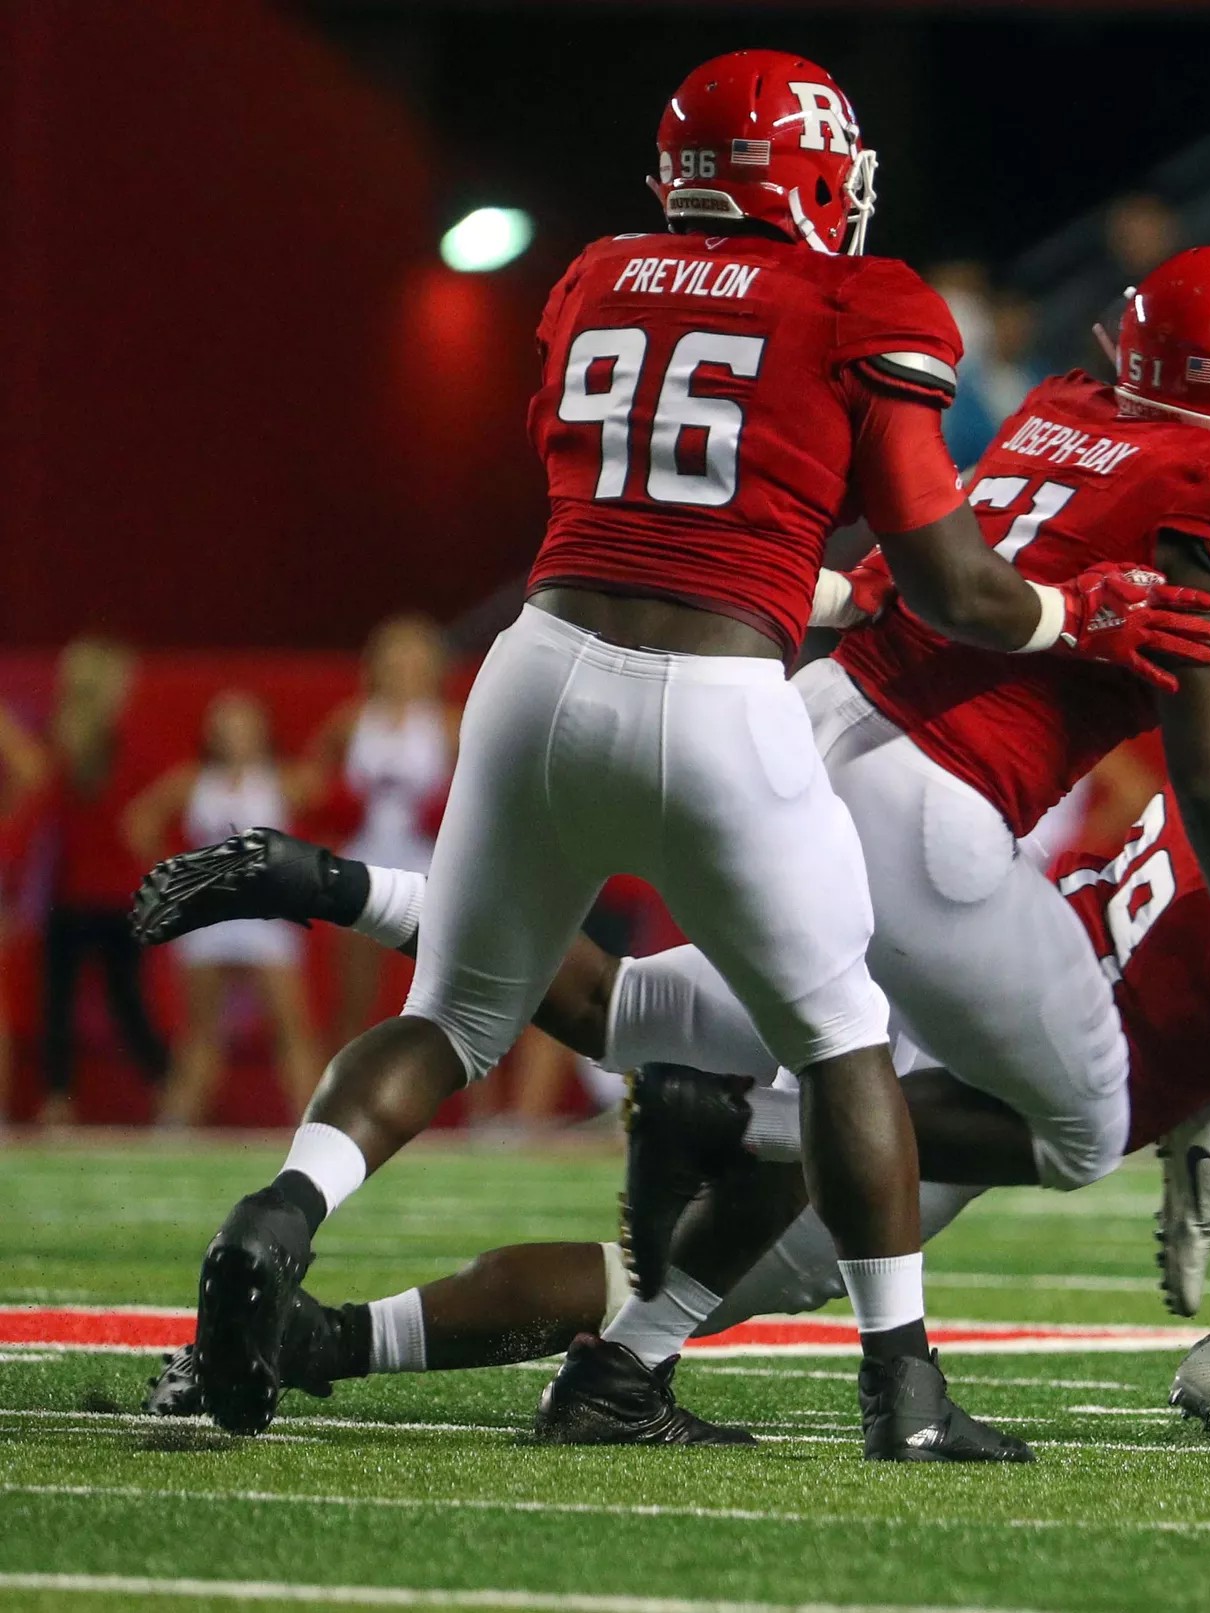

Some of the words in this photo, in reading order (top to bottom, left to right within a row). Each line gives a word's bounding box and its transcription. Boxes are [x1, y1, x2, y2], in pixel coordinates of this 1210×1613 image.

[788, 81, 849, 155] R
[680, 149, 716, 178] 96
[669, 197, 731, 212] RUTGERS
[613, 257, 760, 298] PREVILON
[1129, 350, 1162, 388] 51
[558, 327, 768, 506] 96
[1002, 415, 1140, 475] JOSEPH-DAY
